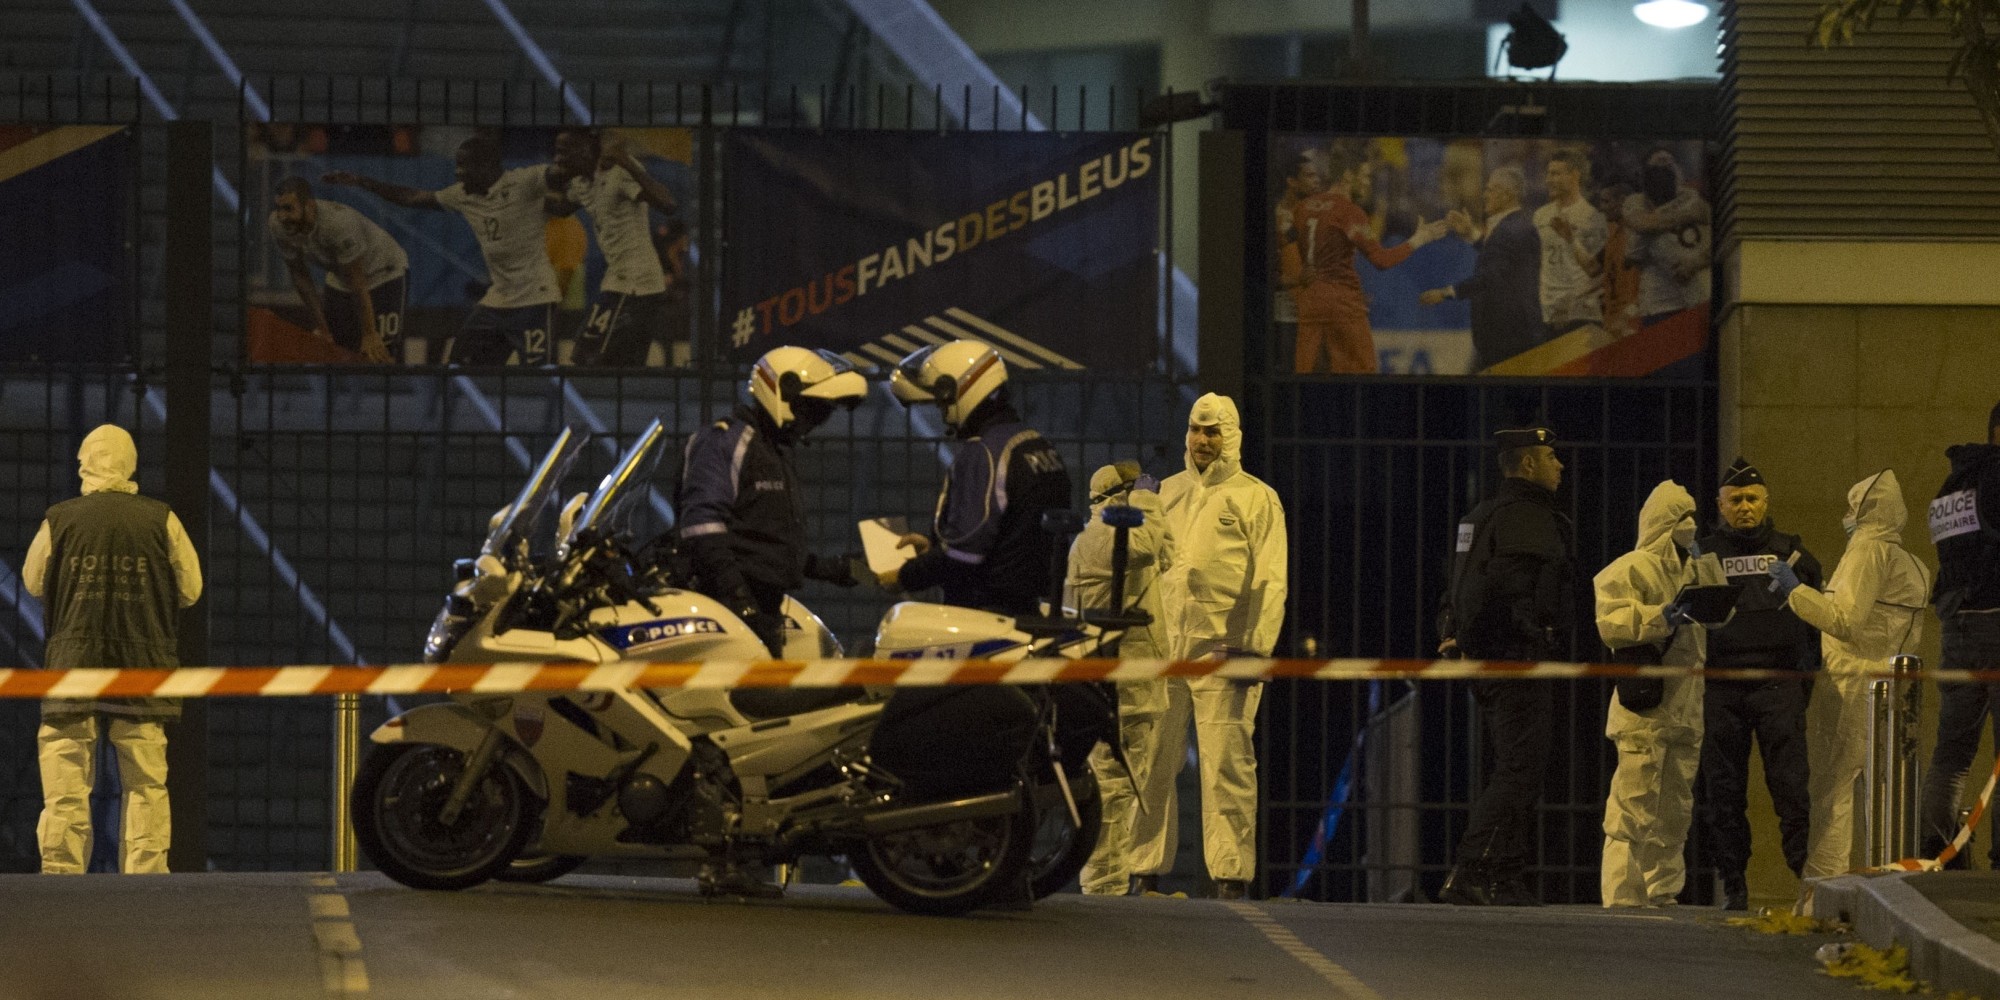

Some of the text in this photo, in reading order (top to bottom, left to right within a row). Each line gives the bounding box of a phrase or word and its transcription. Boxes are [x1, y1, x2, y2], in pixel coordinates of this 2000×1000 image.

[731, 137, 1152, 349] #TOUSFANSDESBLEUS
[379, 312, 399, 337] 10
[587, 303, 612, 334] 14
[524, 328, 546, 353] 12
[1929, 493, 1974, 523] POLICE
[71, 555, 147, 572] POLICE
[649, 620, 719, 640] POLICE
